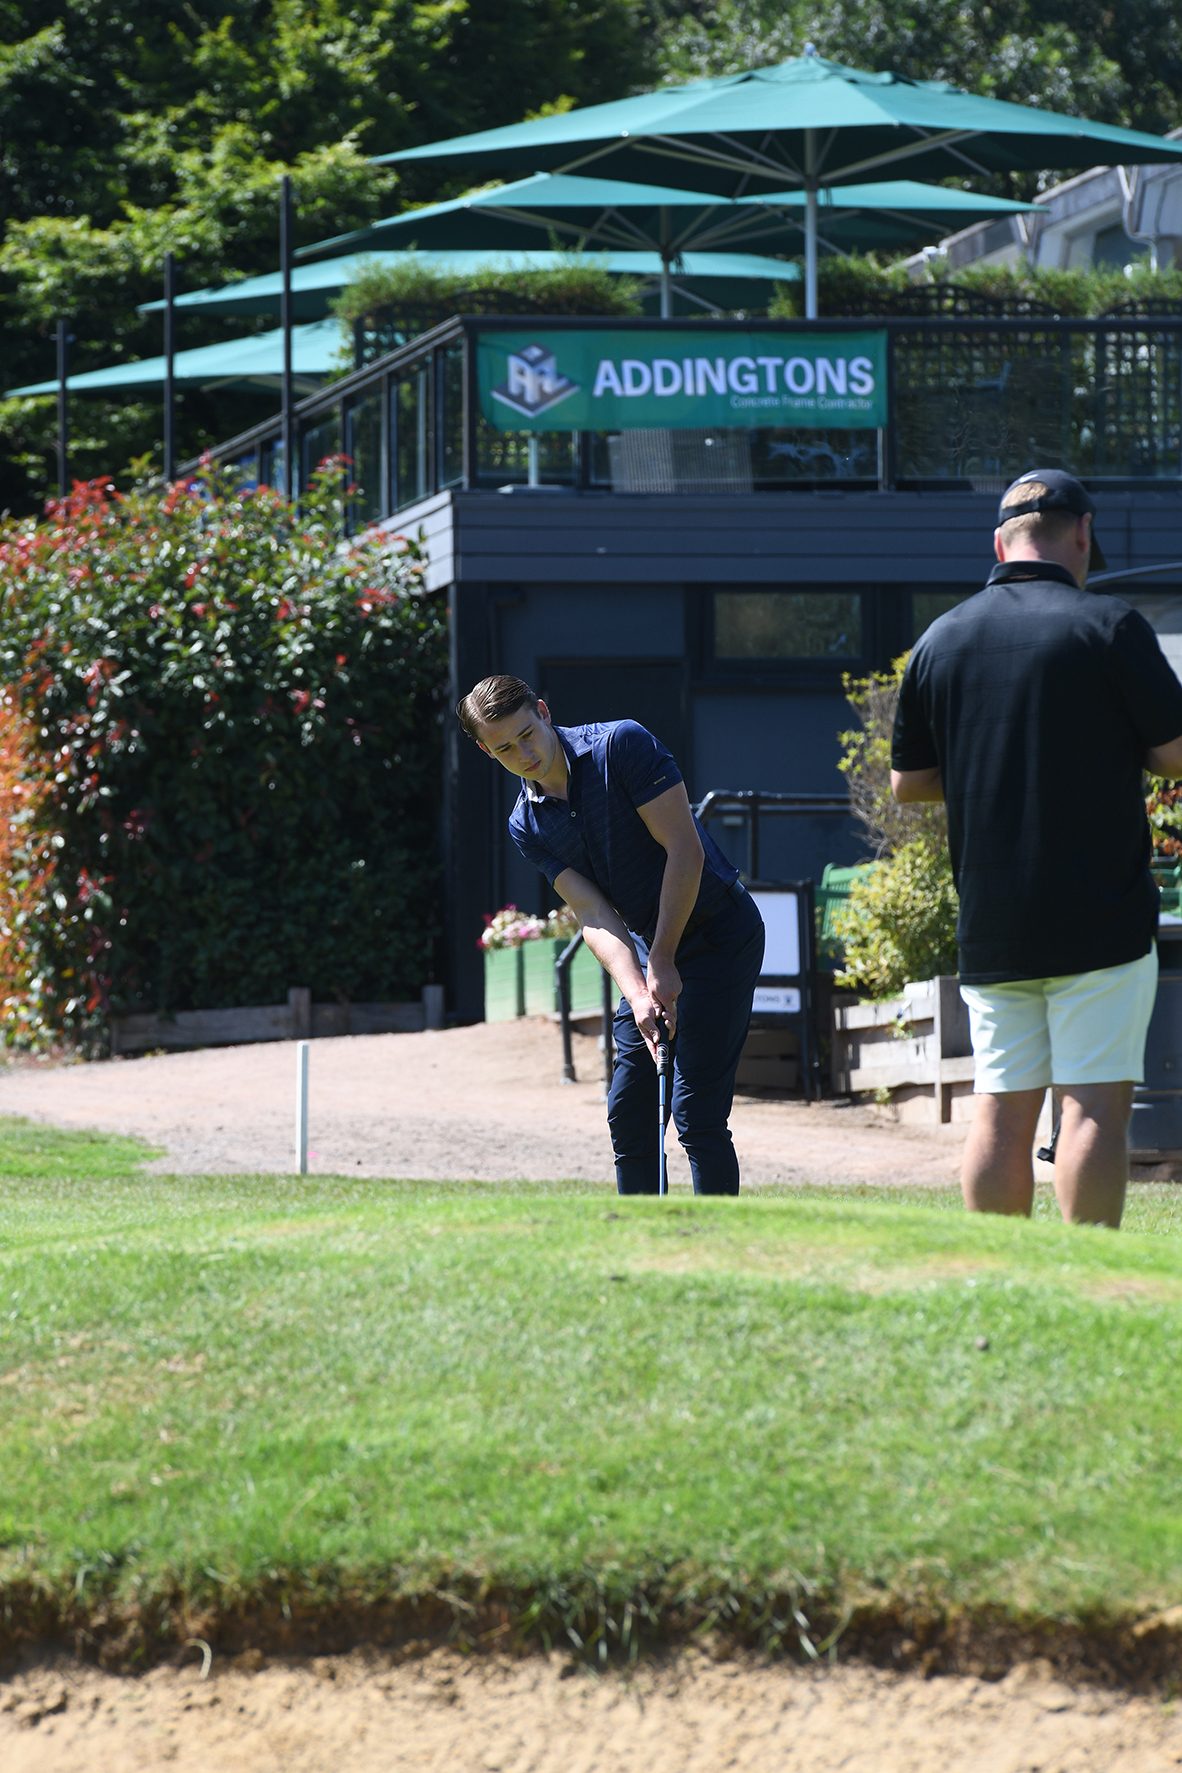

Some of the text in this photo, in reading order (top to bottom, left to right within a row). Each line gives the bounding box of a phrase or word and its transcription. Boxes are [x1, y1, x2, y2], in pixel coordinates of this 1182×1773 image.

[592, 355, 875, 397] ADDINGTONS
[730, 394, 873, 411] Concrete Frame Contractor
